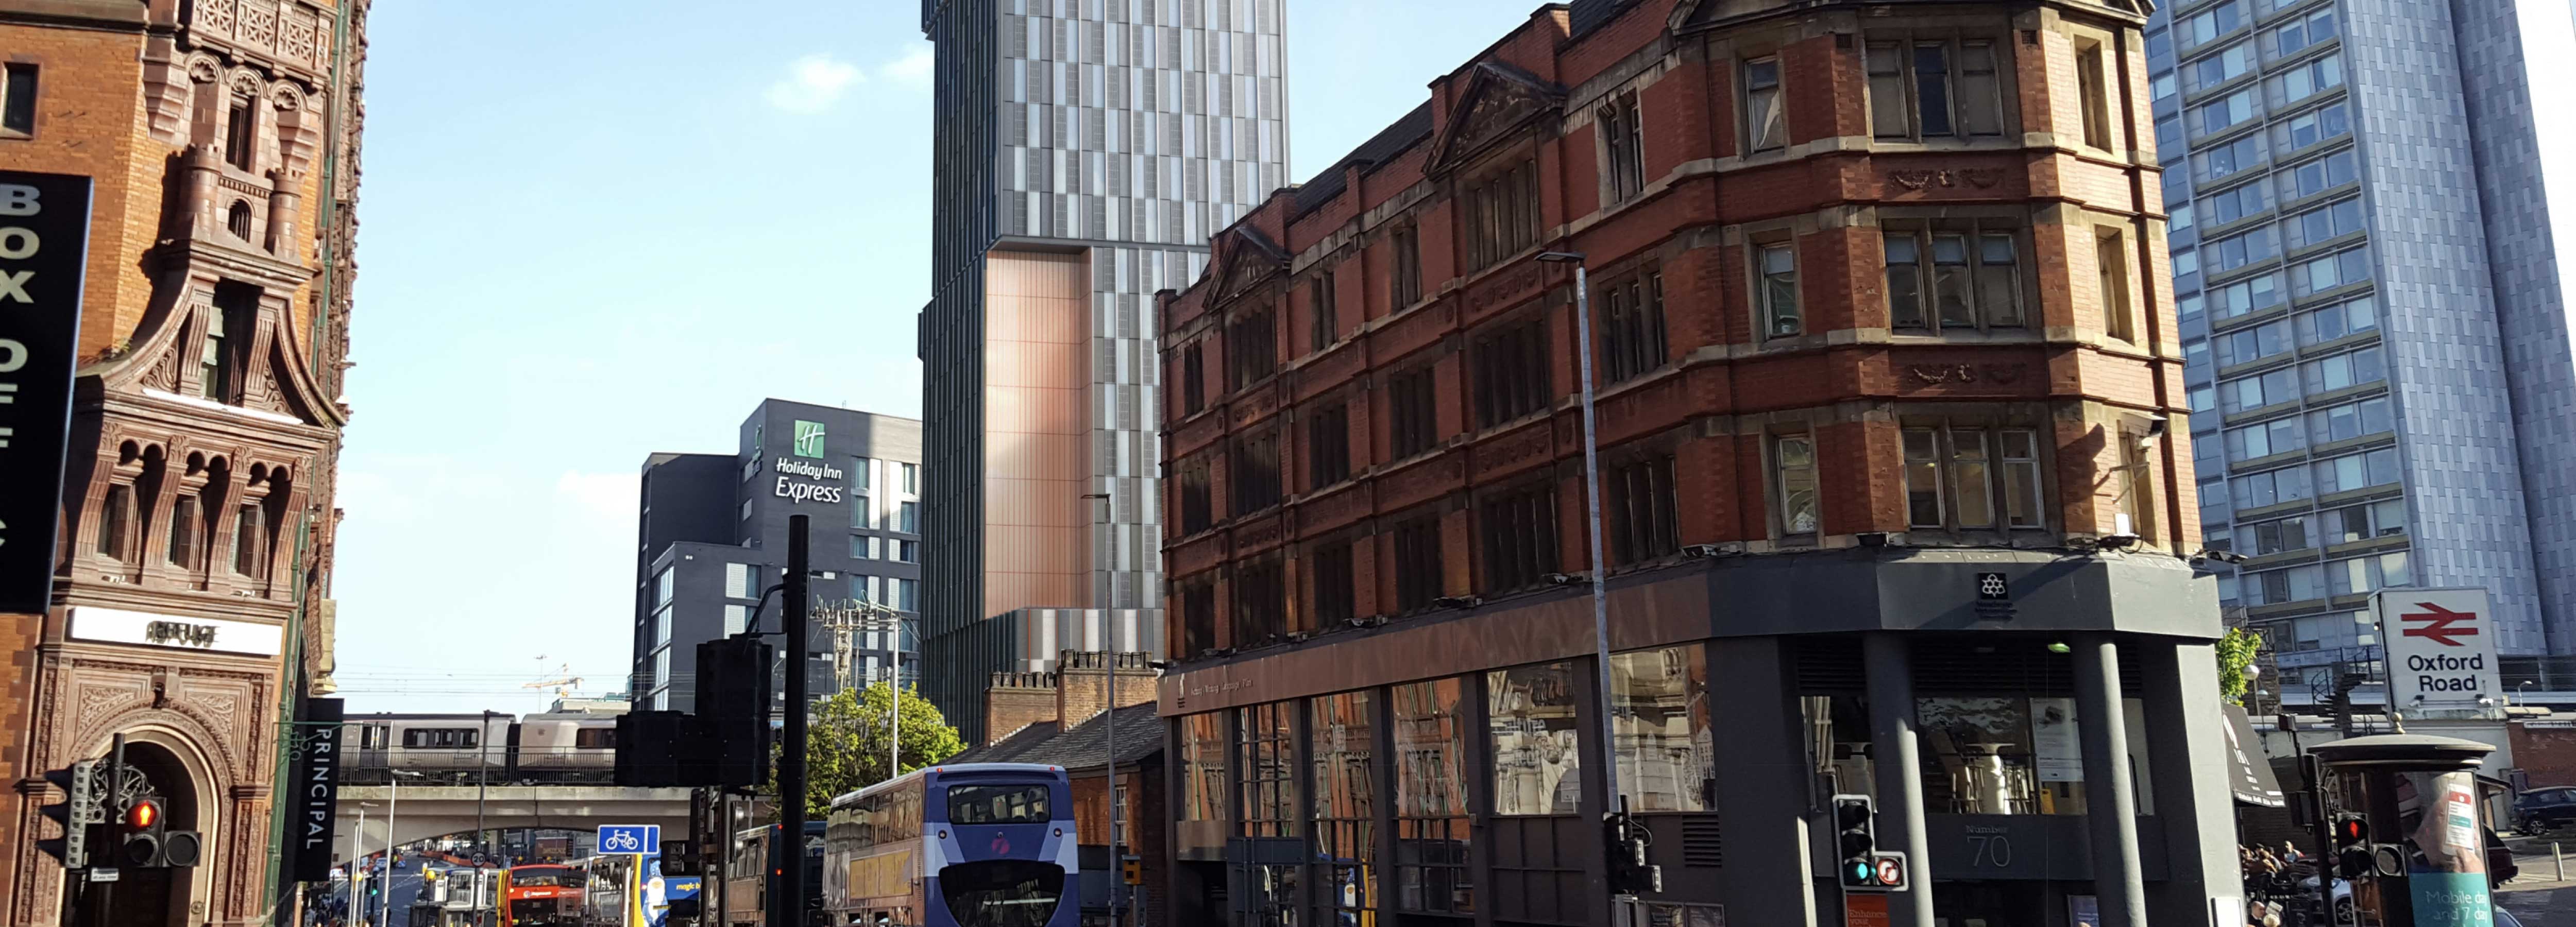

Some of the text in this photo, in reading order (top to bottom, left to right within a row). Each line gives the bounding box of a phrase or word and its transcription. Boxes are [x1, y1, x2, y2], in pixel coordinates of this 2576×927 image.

[0, 183, 41, 304] BOX
[776, 457, 823, 480] Holiday
[824, 464, 842, 479] Inn
[775, 476, 842, 504] Express
[2408, 653, 2483, 671] Oxford
[2419, 674, 2477, 692] Road
[306, 729, 332, 849] PRINCIPAL
[1967, 835, 2010, 867] 70
[676, 882, 694, 891] magic
[2426, 890, 2472, 904] Mobile
[2433, 908, 2460, 920] and
[2462, 907, 2470, 920] 7
